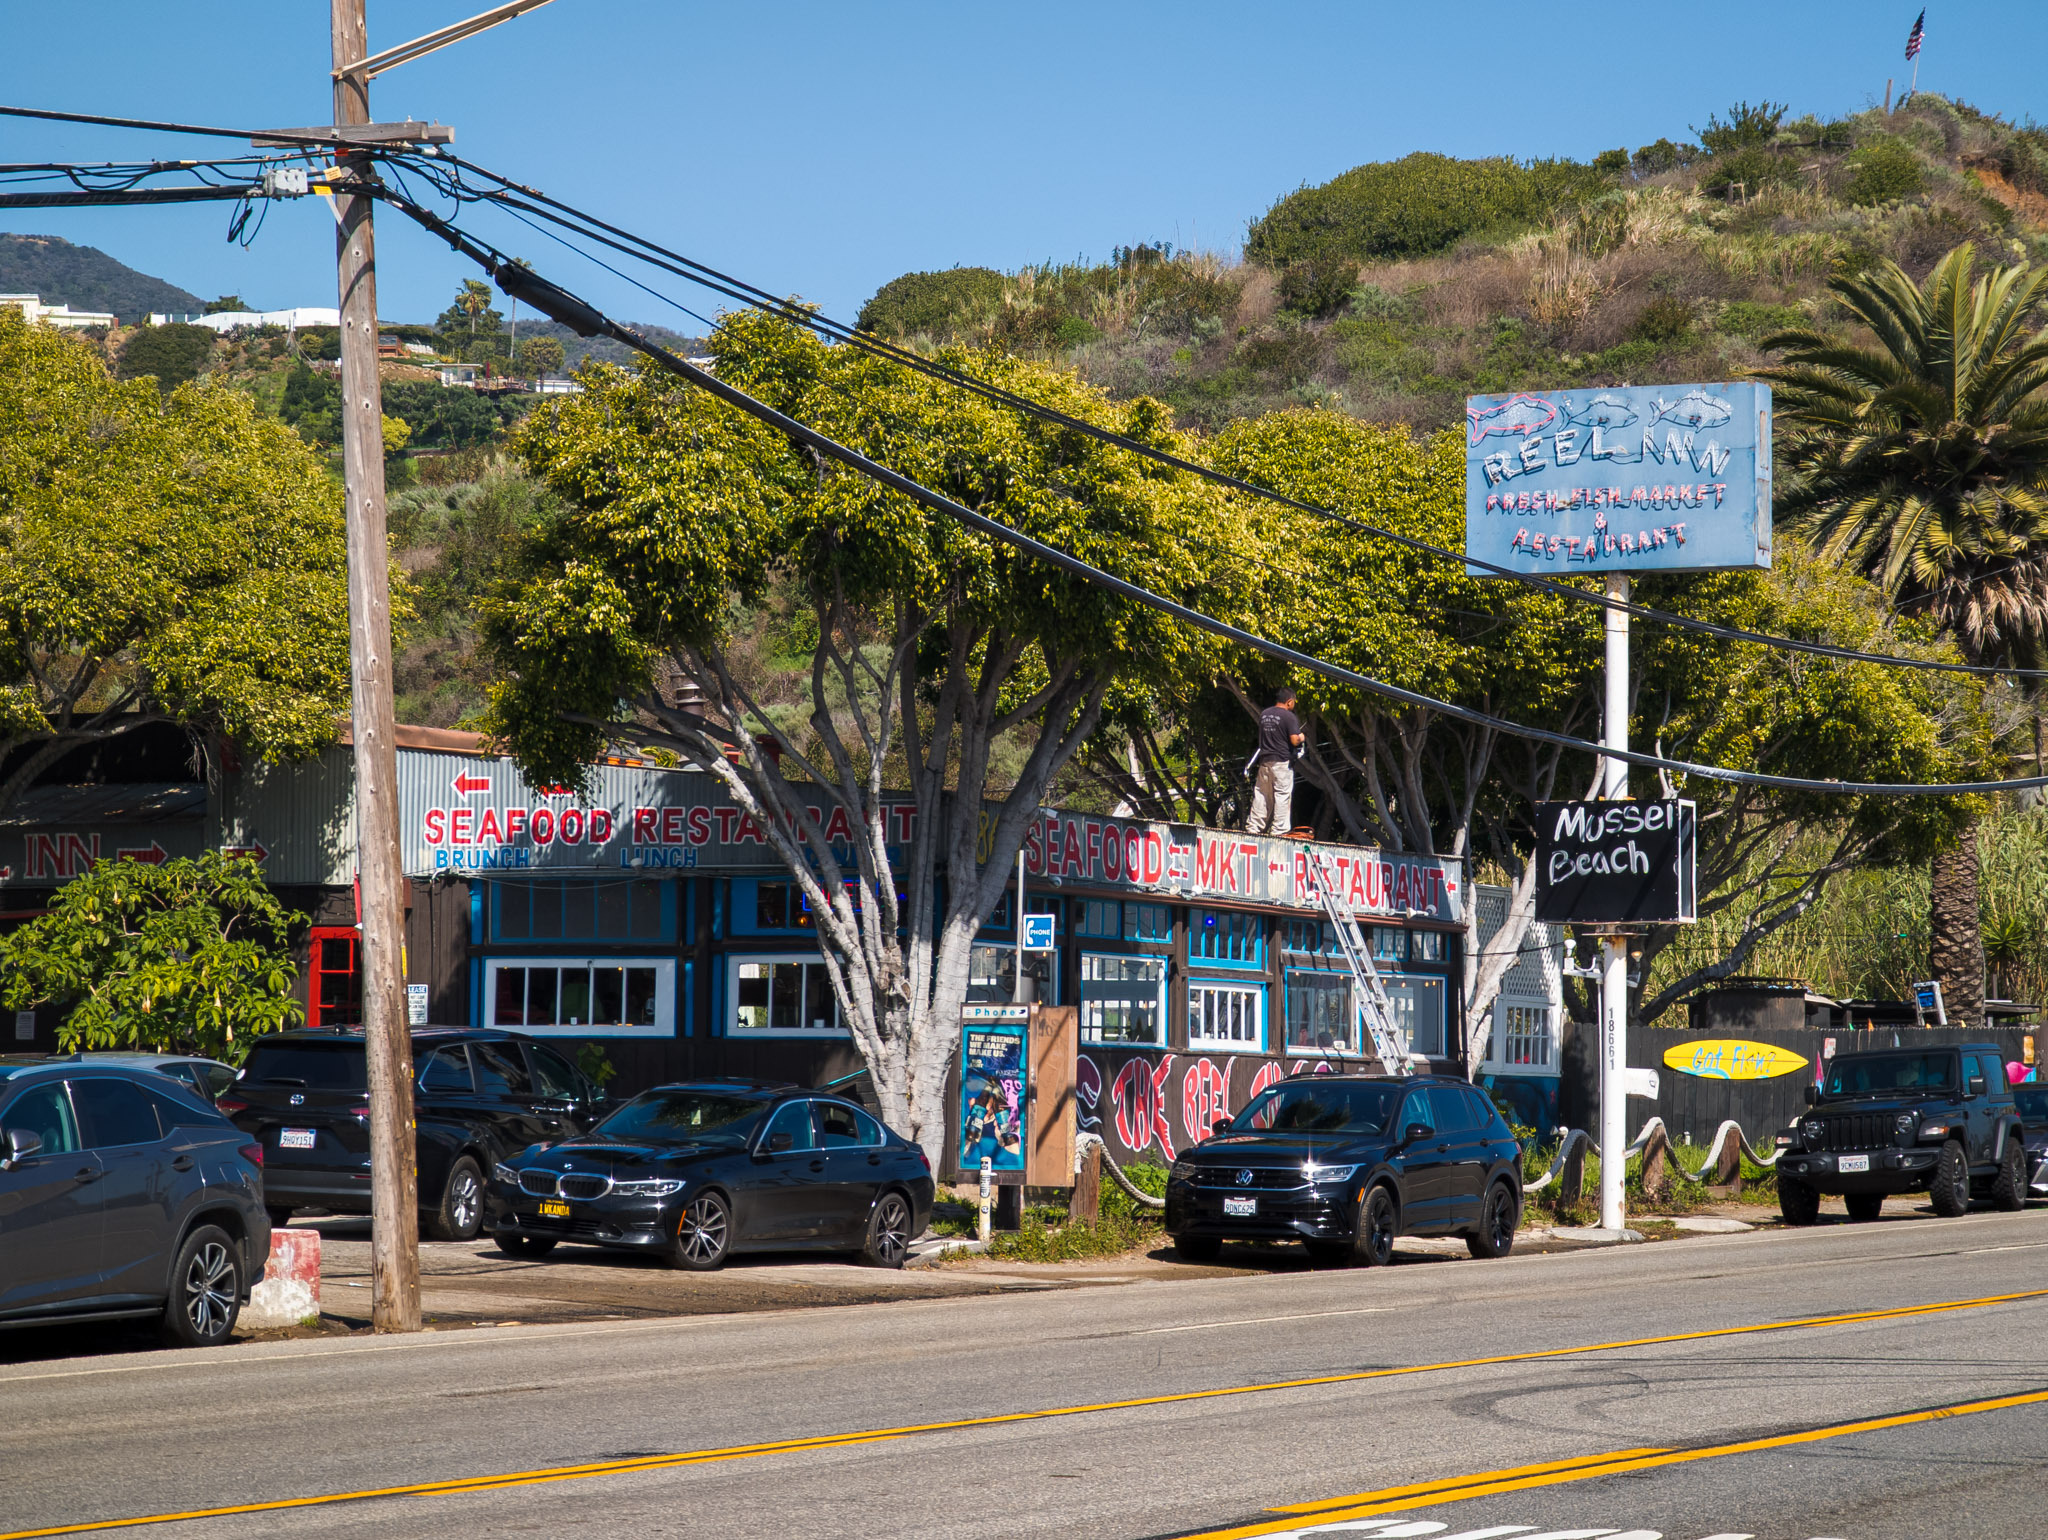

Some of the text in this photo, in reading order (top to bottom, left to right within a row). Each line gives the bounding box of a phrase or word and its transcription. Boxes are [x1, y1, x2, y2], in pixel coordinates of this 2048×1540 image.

[1482, 426, 1627, 488] REEL
[1487, 483, 1727, 513] FRESH FISH MARKET
[1594, 511, 1608, 530] &
[1511, 522, 1687, 558] RESTAURANT
[423, 806, 614, 846] SEAFOOD
[1554, 803, 1673, 843] Mussel
[23, 832, 102, 880] INN
[435, 847, 530, 869] BRUNCH
[620, 847, 699, 868] LUNCH
[1025, 817, 1164, 885] SEAFOOD
[1195, 836, 1258, 895] MKT
[1549, 840, 1649, 885] Beach
[975, 1008, 1016, 1017] Phone
[968, 1048, 992, 1057] MAKE
[970, 1033, 1021, 1045] THE FRIENDS
[970, 1041, 982, 1049] WE
[1607, 1007, 1615, 1071] 18661
[1692, 1046, 1724, 1069] Got
[1112, 1054, 1178, 1162] THE
[1183, 1056, 1237, 1146] REEL
